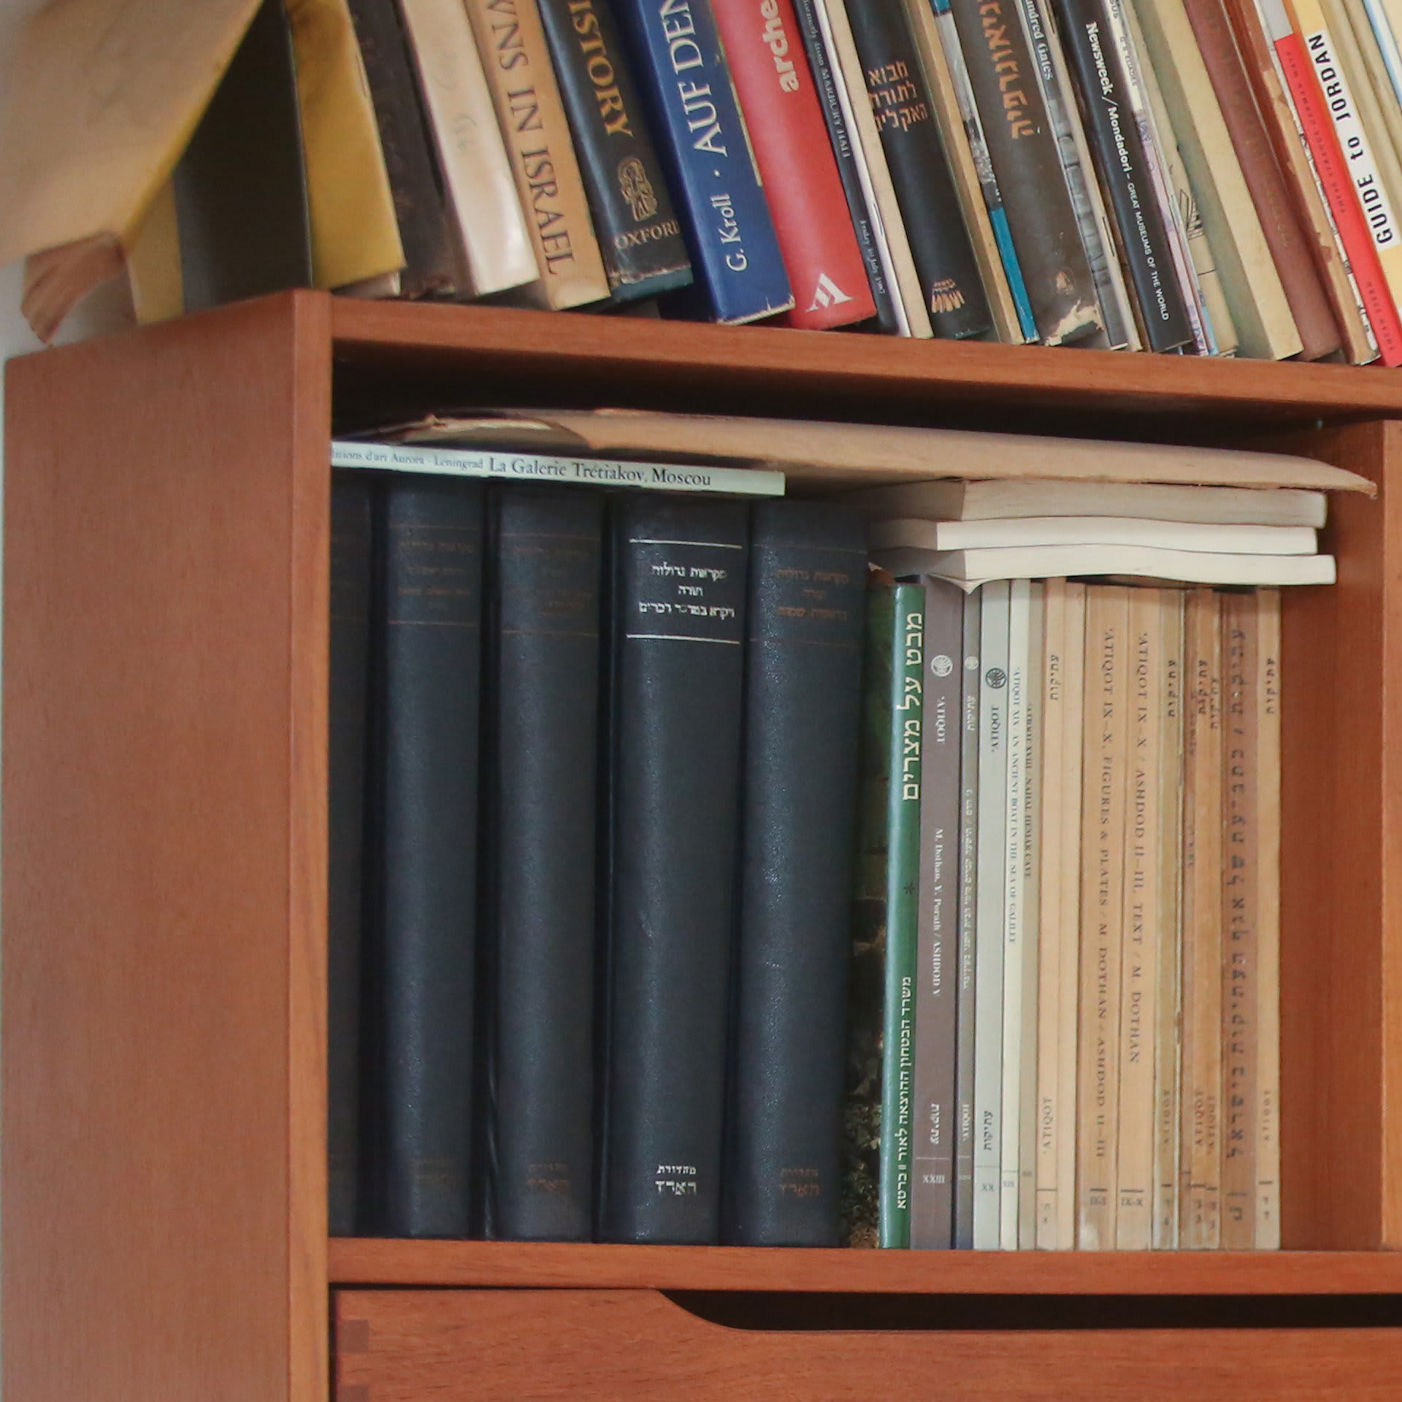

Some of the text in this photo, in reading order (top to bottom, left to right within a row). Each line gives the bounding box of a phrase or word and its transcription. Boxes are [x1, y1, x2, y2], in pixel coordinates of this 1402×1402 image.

[868, 62, 907, 85] מבוא
[980, 3, 1038, 138] גיאוגרפיה
[1033, 42, 1058, 80] Gates
[1309, 35, 1392, 243] GUIDE to JORDAN
[507, 87, 572, 273] IN ISRAEL
[678, 82, 747, 271] G. Kroll AUF
[1127, 182, 1168, 320] GREAT MUSEUMS OF THE WORLD
[489, 457, 710, 485] La Galerie Trétiakov, Moscou
[896, 613, 922, 800] מבט על מצרים
[1049, 654, 1060, 699] עתיקות
[932, 941, 941, 985] ASHDOD
[1096, 757, 1111, 1106] FIGURES PLATES DOTHAN ASHDOD
[1129, 769, 1145, 1061] ASHDOD TEXT DOTHAN
[1226, 855, 1244, 1157] של אגף בישראל
[895, 976, 911, 1160] משרד הבטחון ההוצאה לאור
